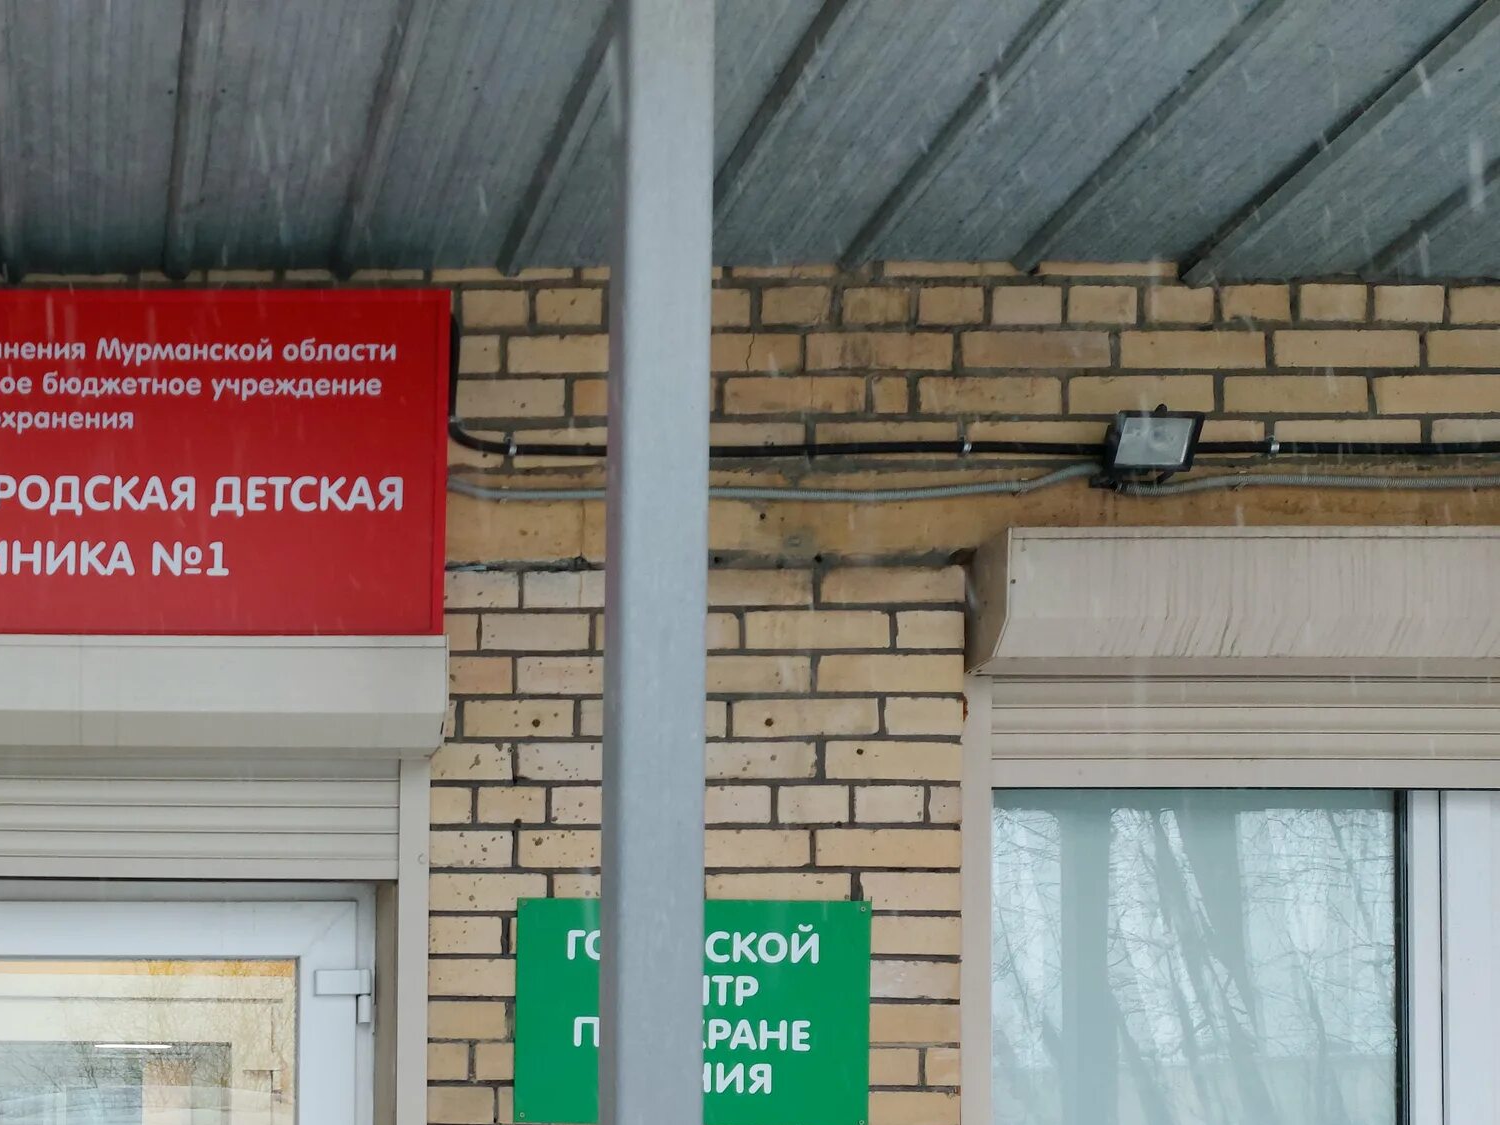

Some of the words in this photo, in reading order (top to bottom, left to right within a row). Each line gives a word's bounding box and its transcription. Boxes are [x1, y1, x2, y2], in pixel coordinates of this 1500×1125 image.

[96, 337, 273, 367] Мурманской
[283, 337, 397, 362] области
[43, 371, 201, 398] бюджетное
[211, 376, 382, 401] учреждение
[210, 475, 403, 516] ДЕТСКАЯ
[151, 541, 229, 578] №1
